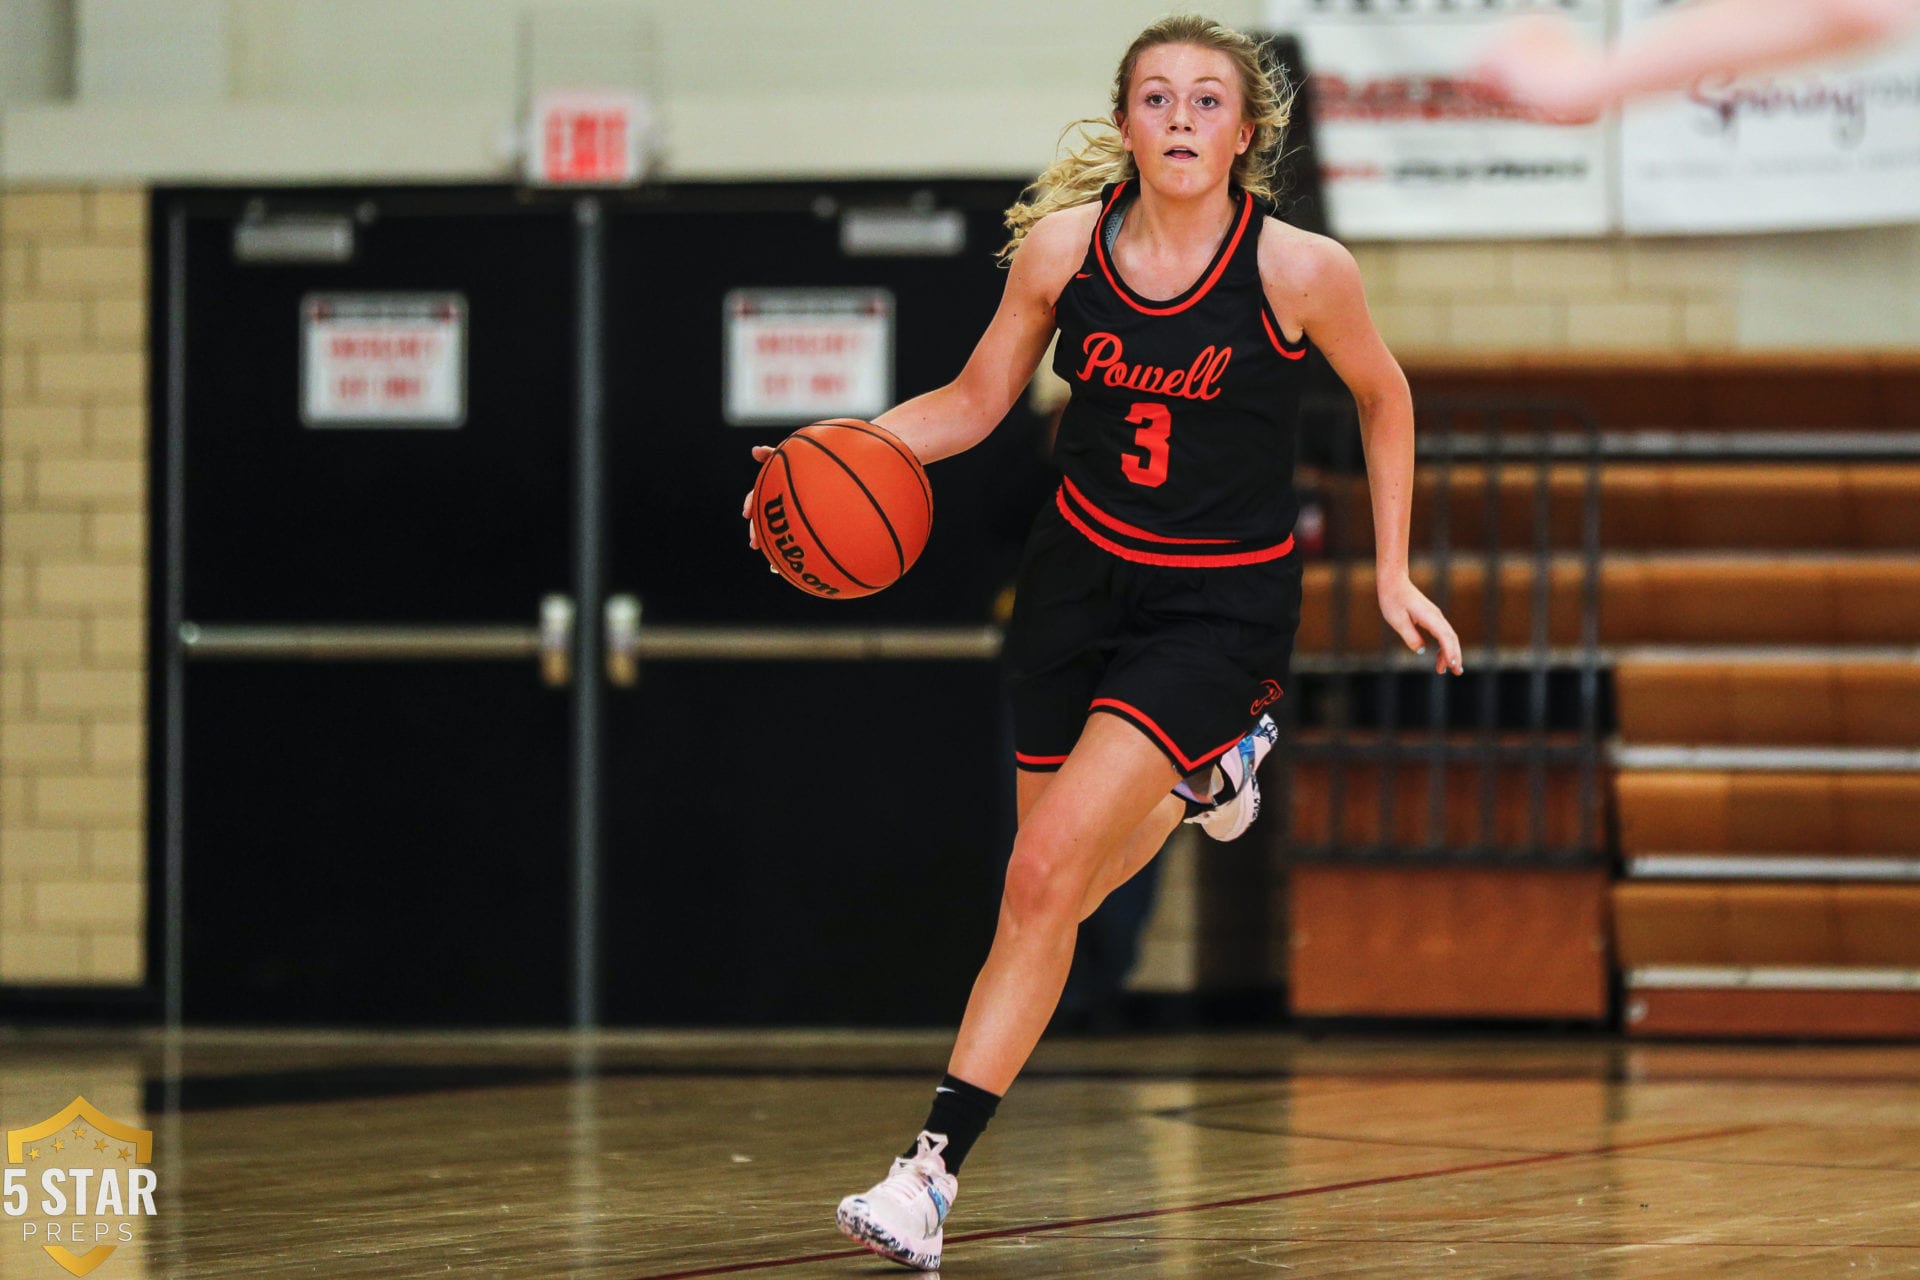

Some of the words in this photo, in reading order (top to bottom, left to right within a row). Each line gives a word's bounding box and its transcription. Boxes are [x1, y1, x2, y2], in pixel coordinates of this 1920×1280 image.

[1076, 331, 1233, 401] Powell
[1121, 402, 1172, 488] 3
[763, 492, 841, 597] Wilson
